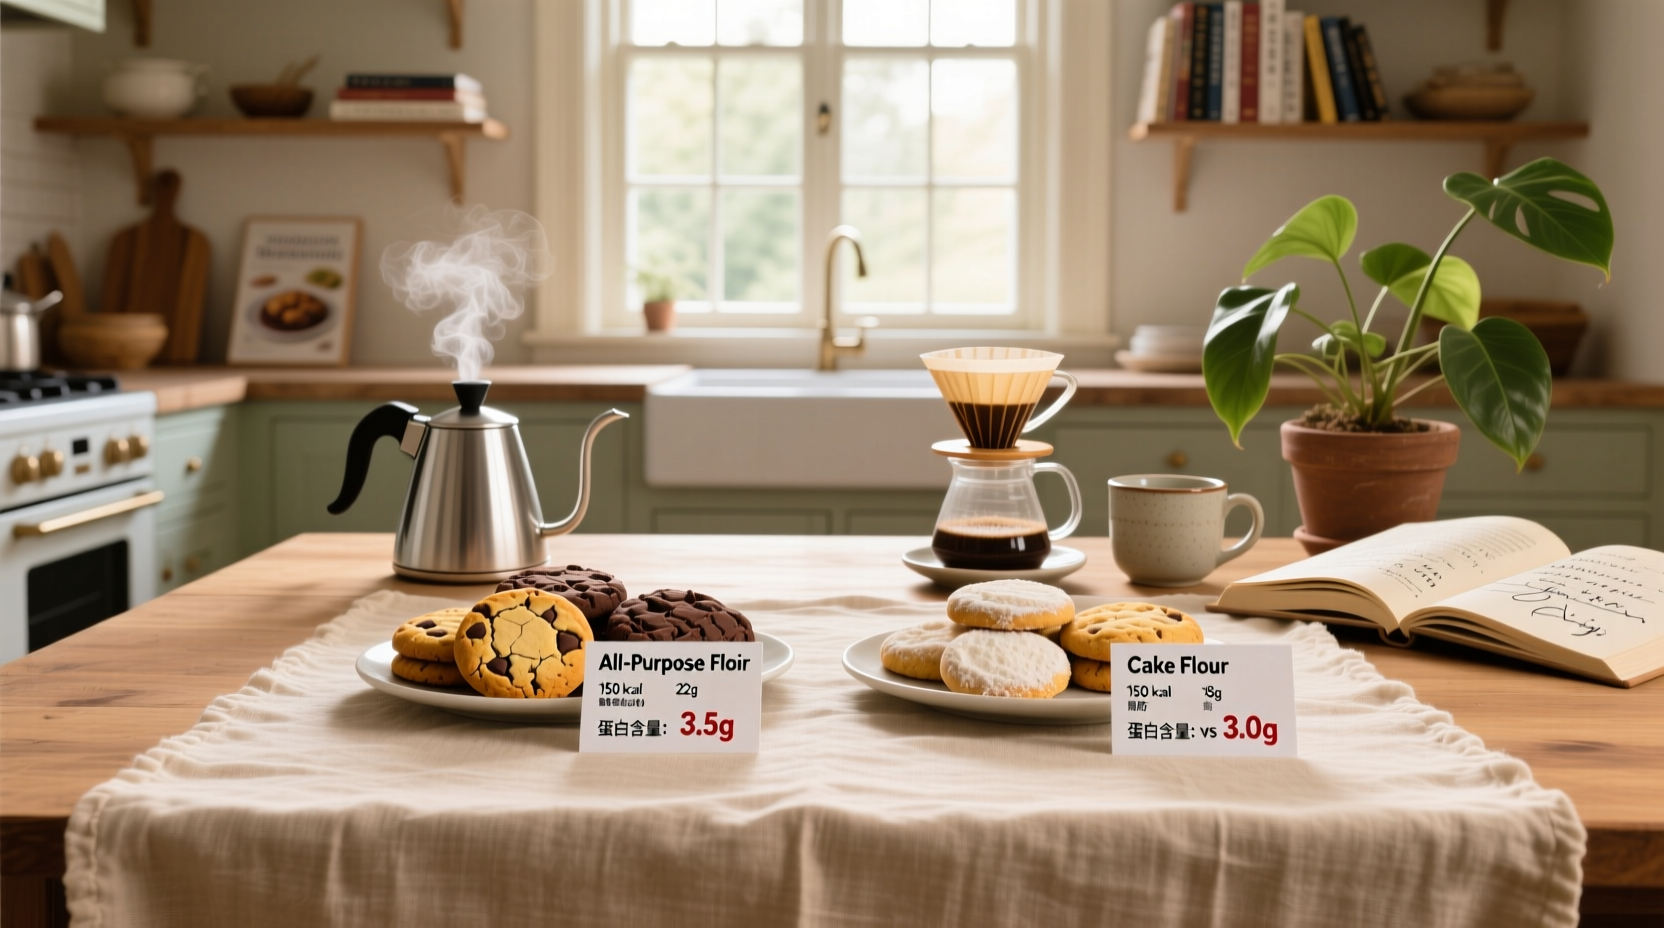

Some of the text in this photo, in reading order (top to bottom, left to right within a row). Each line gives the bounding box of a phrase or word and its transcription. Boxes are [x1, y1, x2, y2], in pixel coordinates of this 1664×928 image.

[599, 653, 706, 675] All-Purpose
[1127, 655, 1230, 674] Cake Flour
[599, 682, 620, 695] 150
[675, 683, 698, 698] 22g
[1127, 685, 1149, 697] 150
[680, 711, 734, 742] 3.5g
[1200, 726, 1217, 738] vs
[1223, 715, 1278, 746] 3.0g
